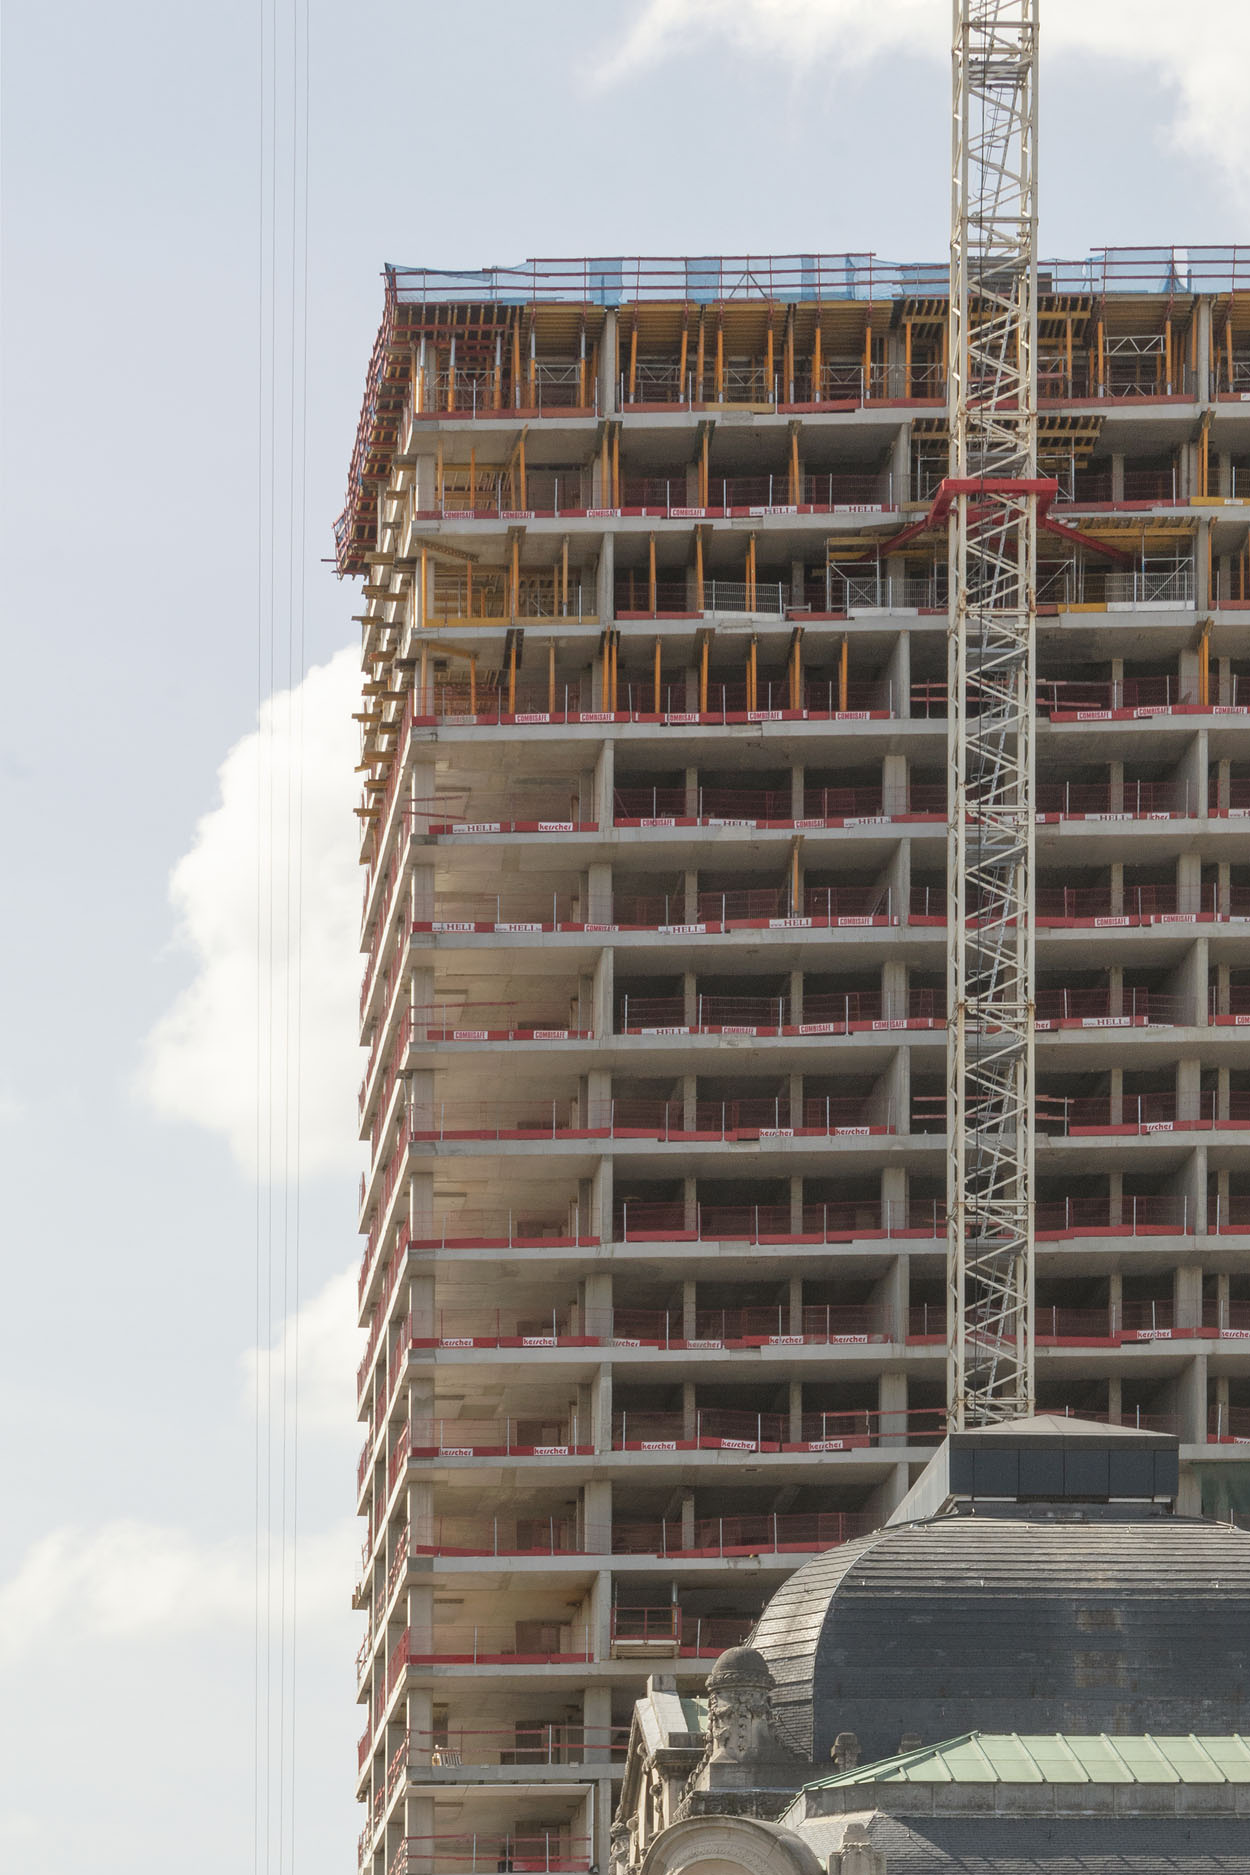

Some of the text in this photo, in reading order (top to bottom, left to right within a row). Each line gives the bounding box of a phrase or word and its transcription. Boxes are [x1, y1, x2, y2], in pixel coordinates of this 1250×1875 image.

[516, 714, 548, 722] COMBISAFE
[539, 822, 572, 831] kerscher
[1096, 918, 1128, 926] COMBISAFE
[873, 1021, 906, 1029] COMBISAFE
[836, 1127, 869, 1135] kerscher
[833, 1336, 867, 1344] kerscher
[641, 1441, 675, 1450] kerscher
[721, 1439, 755, 1449] kerscher
[440, 1448, 473, 1456] kerscher
